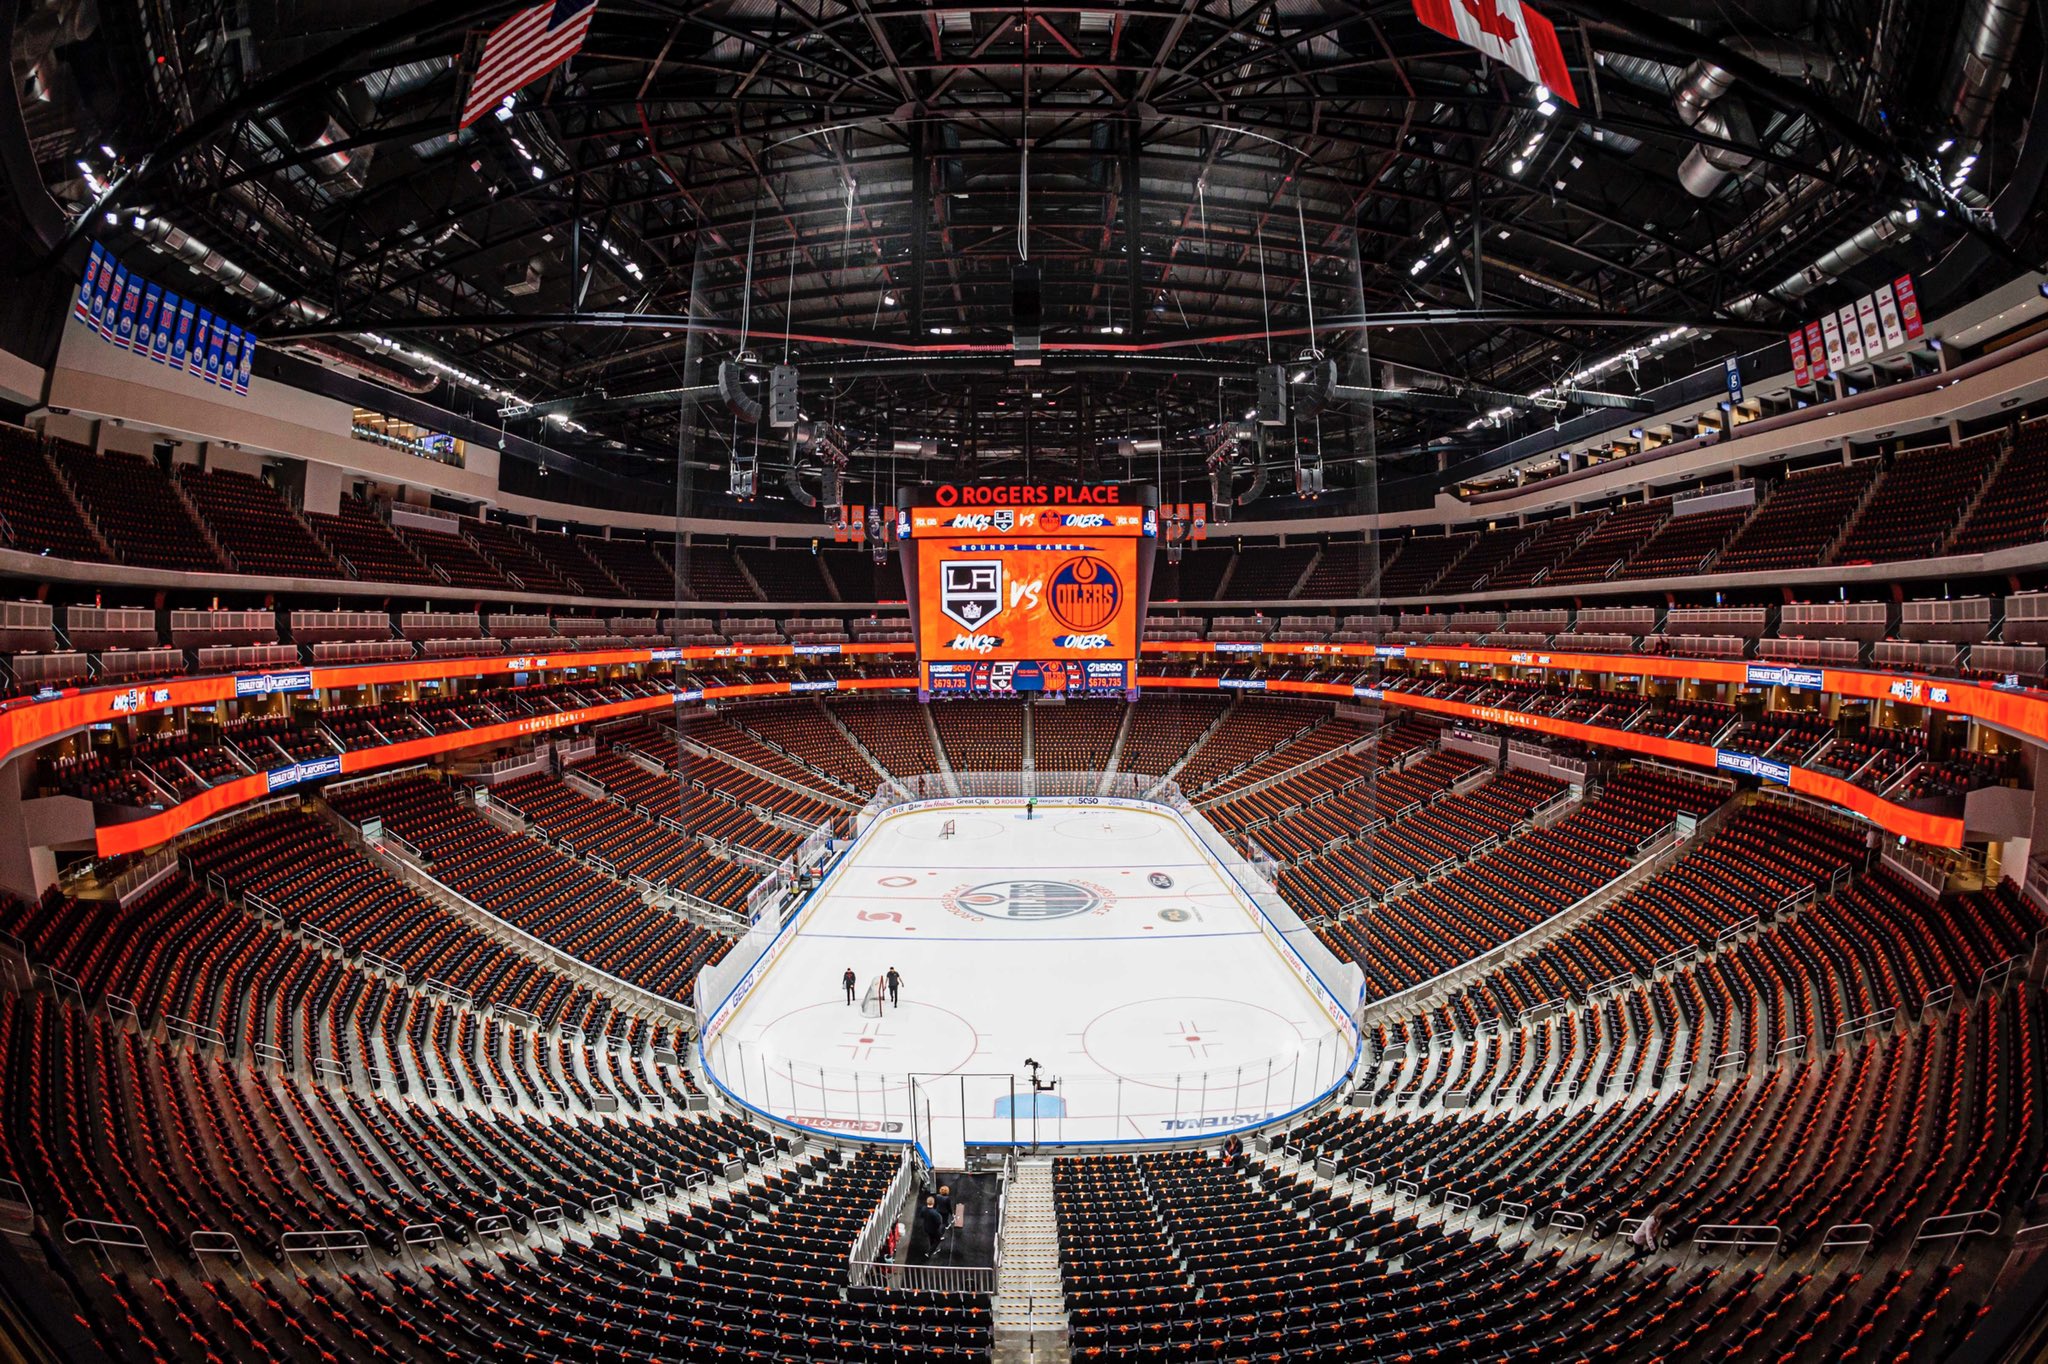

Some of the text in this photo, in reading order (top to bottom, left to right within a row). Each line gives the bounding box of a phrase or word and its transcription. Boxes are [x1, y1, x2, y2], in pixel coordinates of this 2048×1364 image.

[123, 292, 139, 313] 31
[144, 300, 155, 319] 7
[962, 485, 1119, 504] ROGERS PLACE
[951, 513, 991, 532] KINGS
[1019, 513, 1035, 528] VS
[1066, 513, 1105, 528] OILERS
[947, 569, 996, 590] LA
[1009, 579, 1043, 610] VS
[1056, 584, 1114, 610] OILERS
[951, 633, 997, 654] KINGS
[1064, 633, 1108, 650] OILERS
[933, 678, 967, 689] $679,735
[1088, 678, 1121, 688] $679,735
[732, 973, 754, 1008] GEICO
[788, 1116, 879, 1131] CHIPOTLE
[1161, 1112, 1274, 1131] FASTENAL
